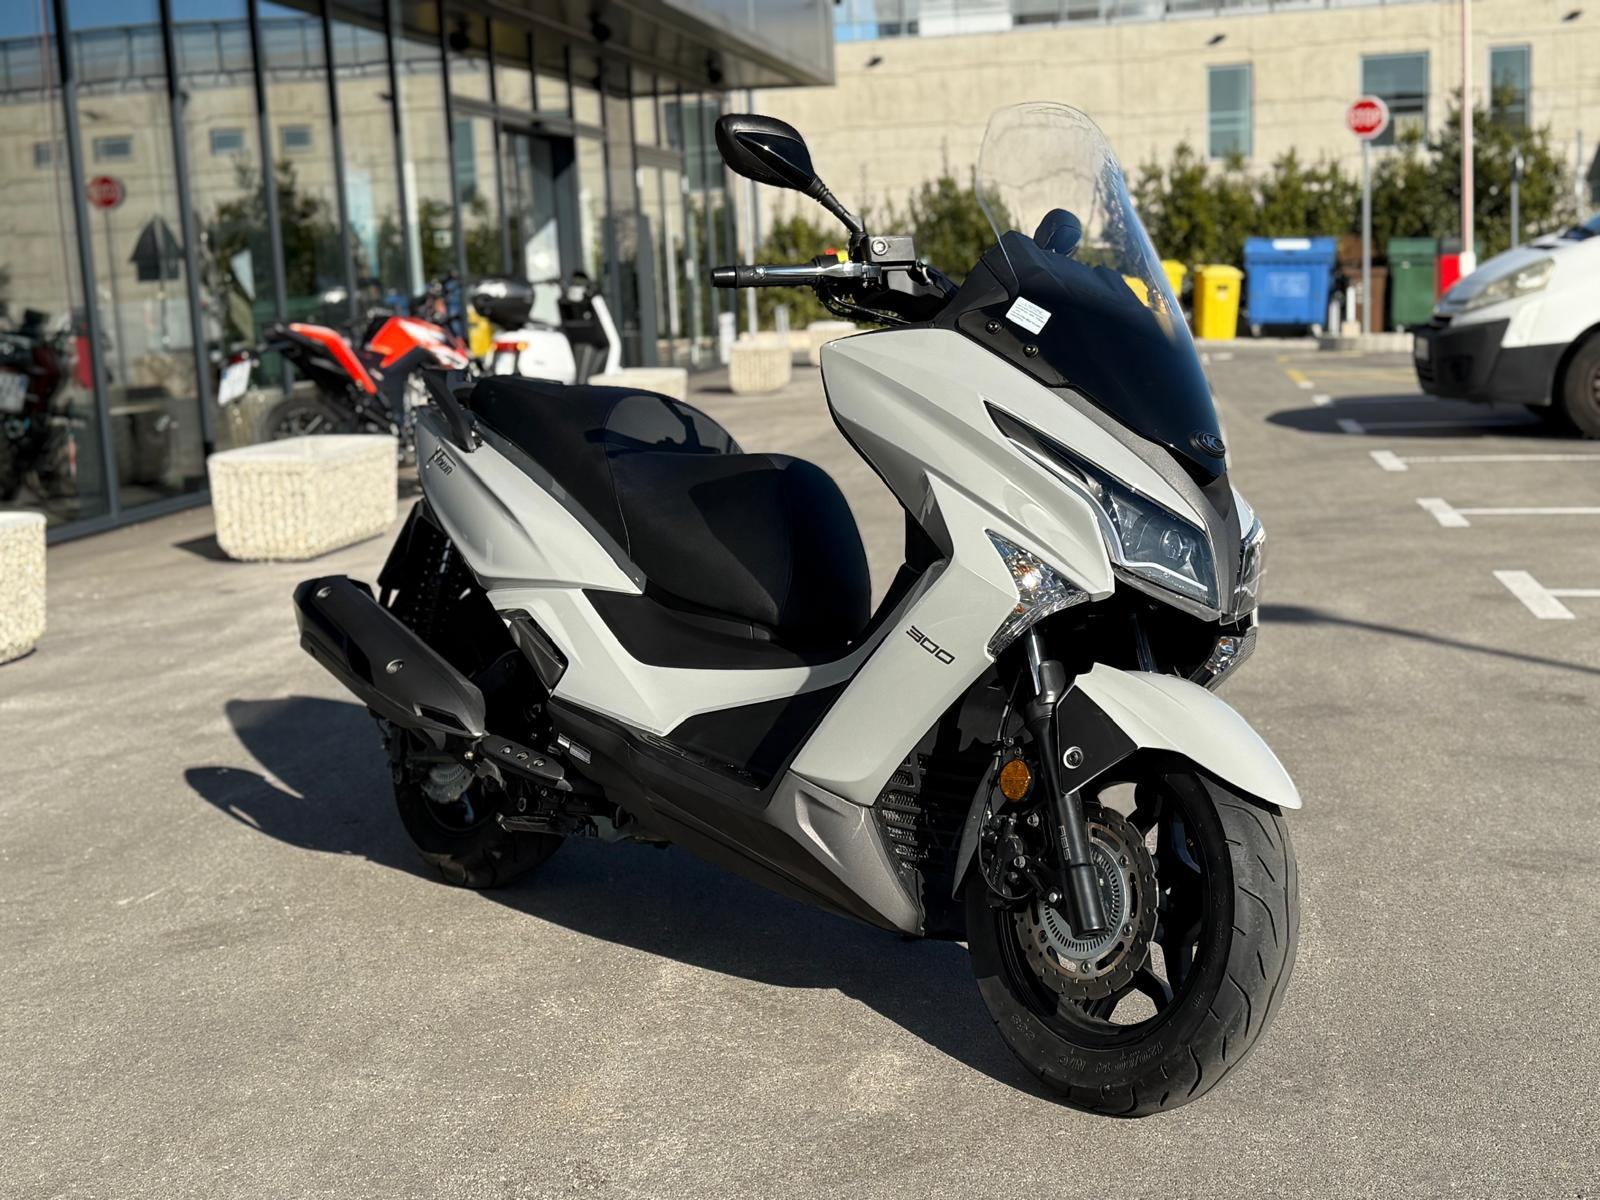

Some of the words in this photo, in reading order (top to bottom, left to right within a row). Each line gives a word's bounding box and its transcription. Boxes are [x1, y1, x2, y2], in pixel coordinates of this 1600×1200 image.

[1350, 108, 1382, 127] STOP
[906, 625, 955, 664] 300
[1058, 825, 1071, 860] ABS
